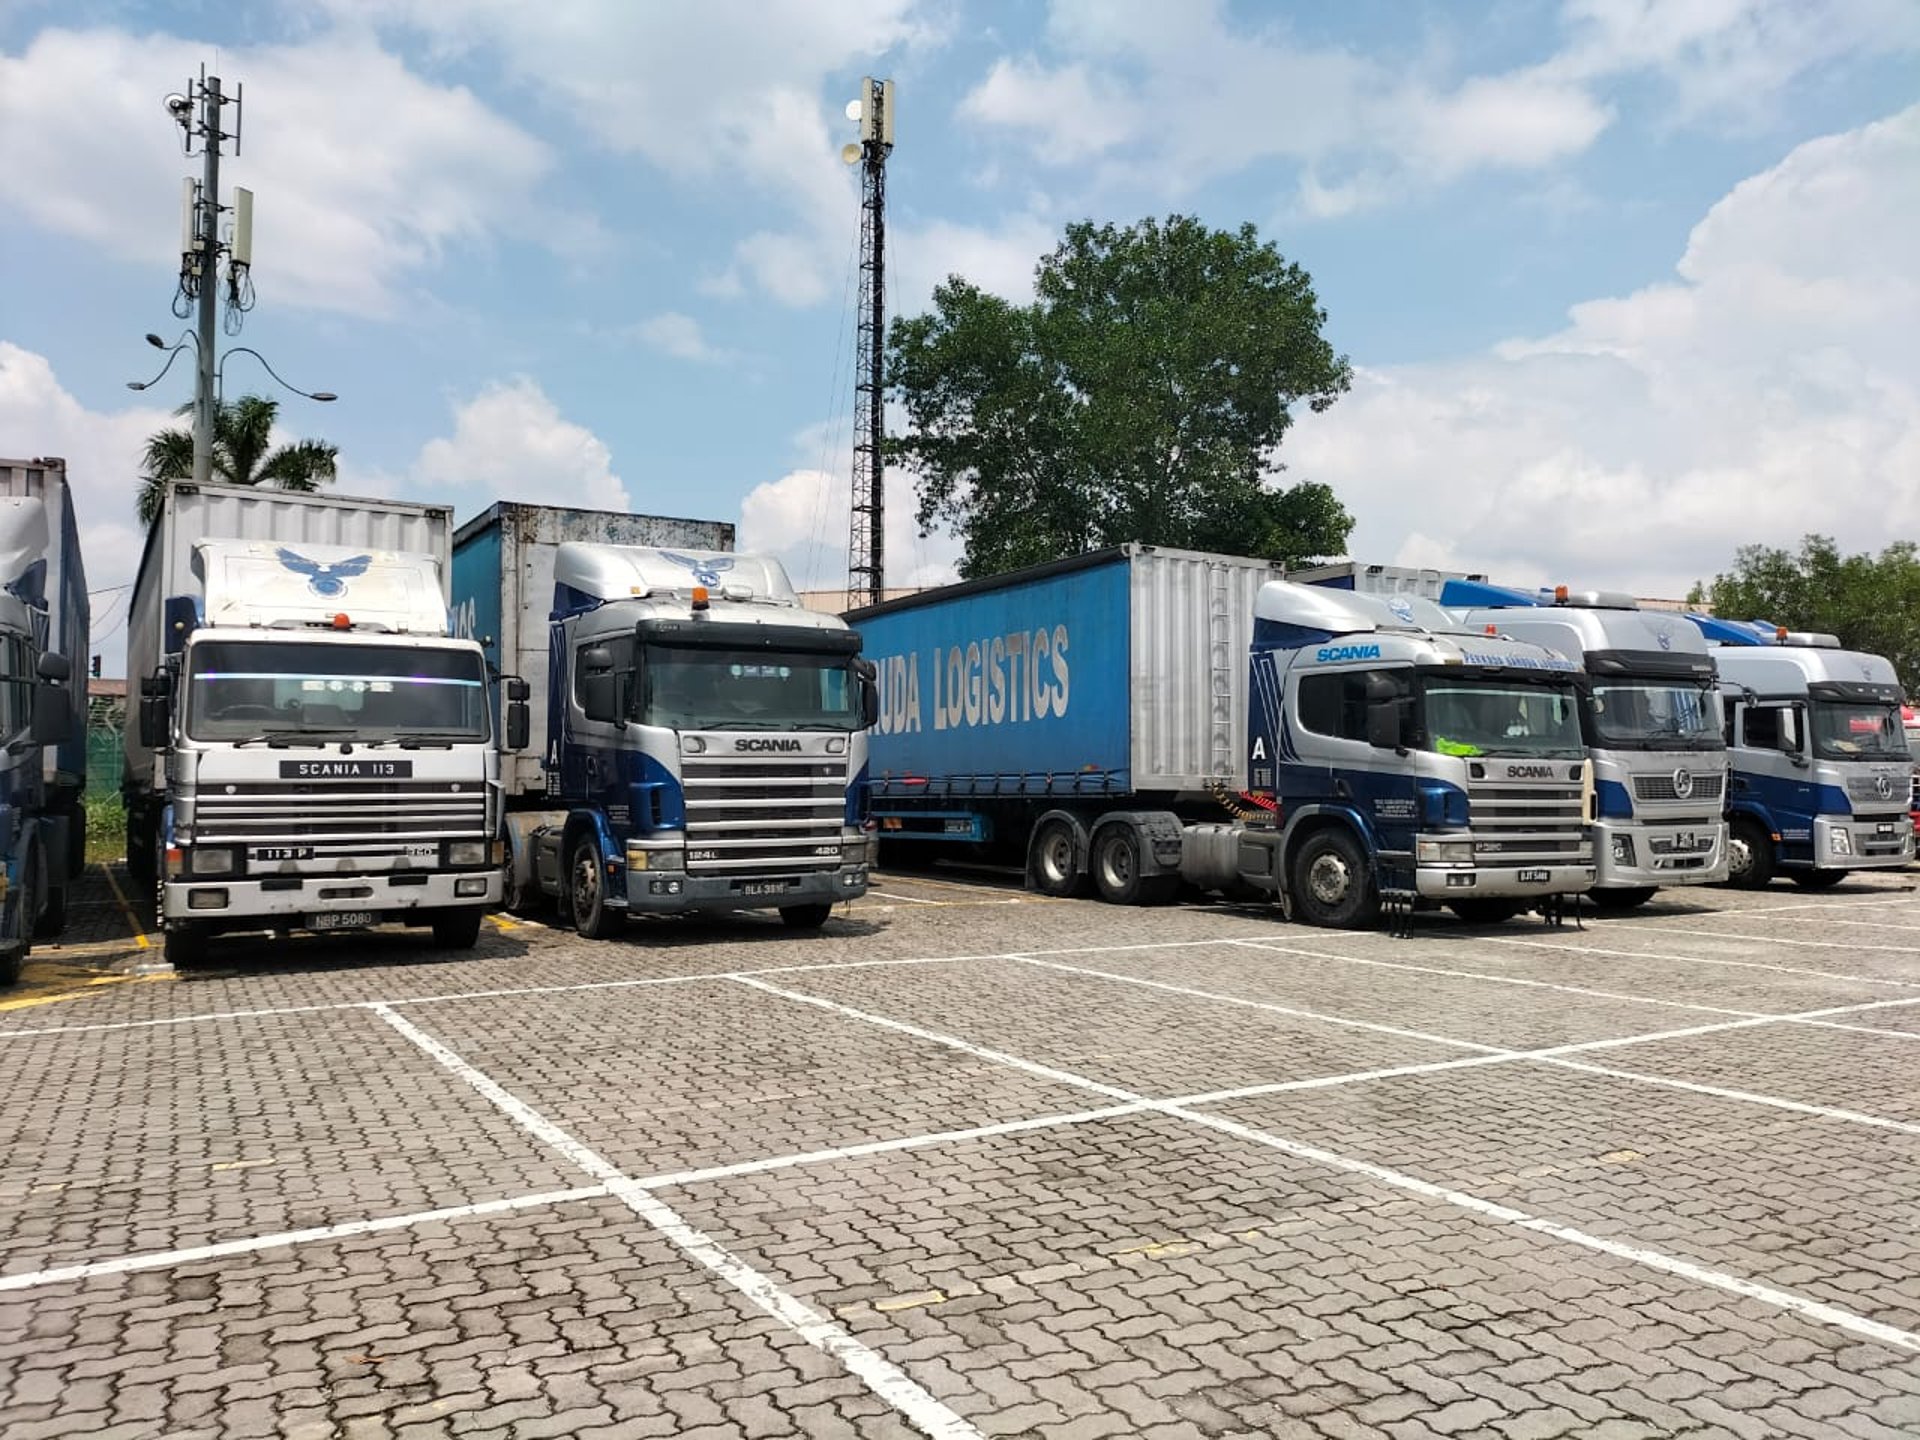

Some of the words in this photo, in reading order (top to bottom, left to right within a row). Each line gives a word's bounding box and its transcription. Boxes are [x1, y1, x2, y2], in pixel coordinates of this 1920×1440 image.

[1317, 645, 1380, 661] SCANIA
[934, 624, 1069, 730] LOGISTICS
[550, 739, 559, 765] A
[735, 739, 802, 752] SCANIA
[1251, 736, 1266, 760] A
[299, 764, 361, 775] SCANIA
[372, 764, 395, 775] 113
[1507, 766, 1554, 778] SCANIA
